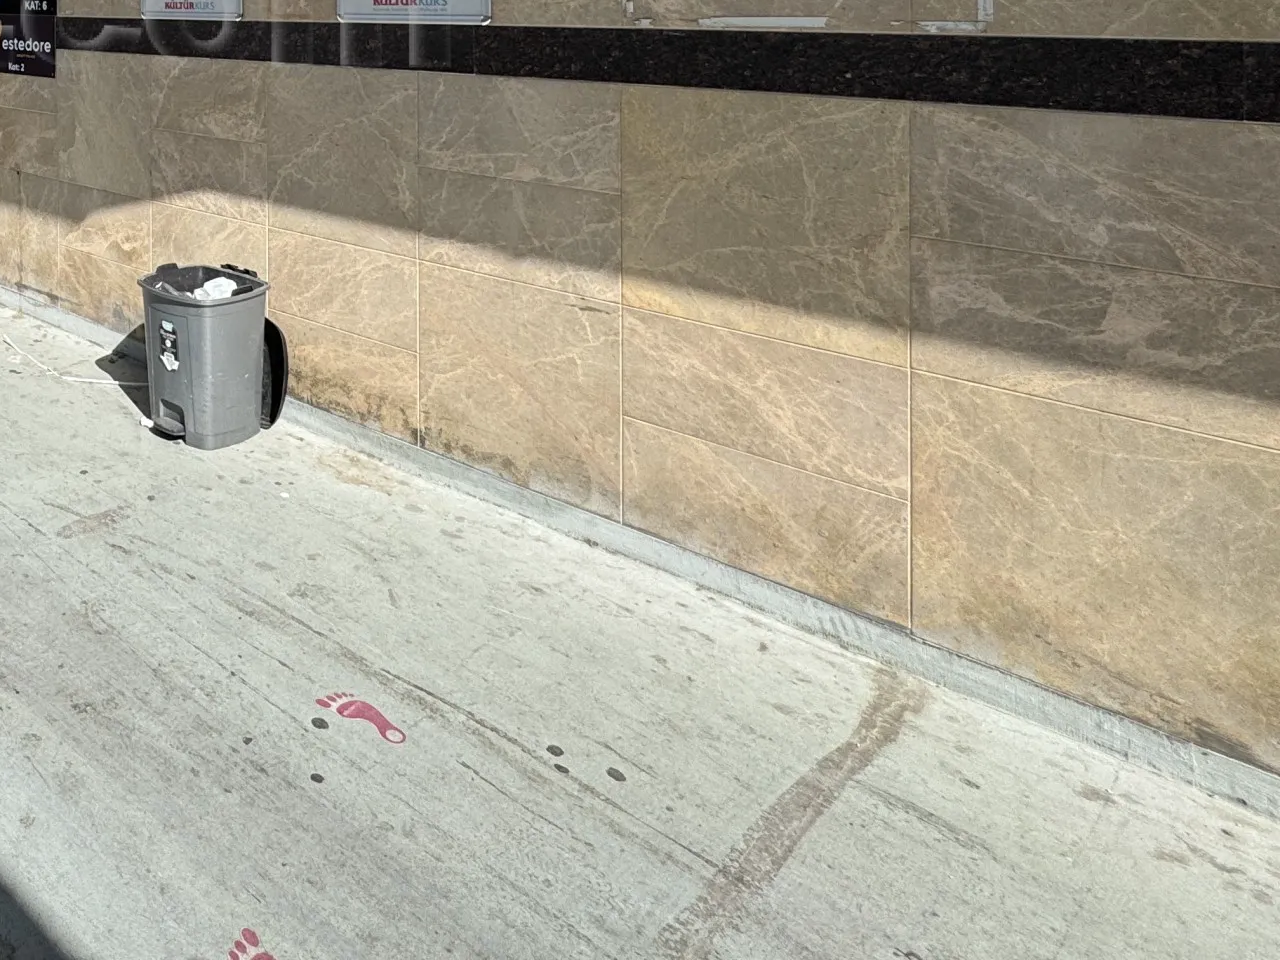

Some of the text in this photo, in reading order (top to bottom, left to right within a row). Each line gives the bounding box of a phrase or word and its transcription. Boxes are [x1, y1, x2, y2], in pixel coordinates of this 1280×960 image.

[24, 1, 48, 10] KAT: 6
[1, 37, 52, 53] estedore
[8, 62, 25, 72] Kat: 2
